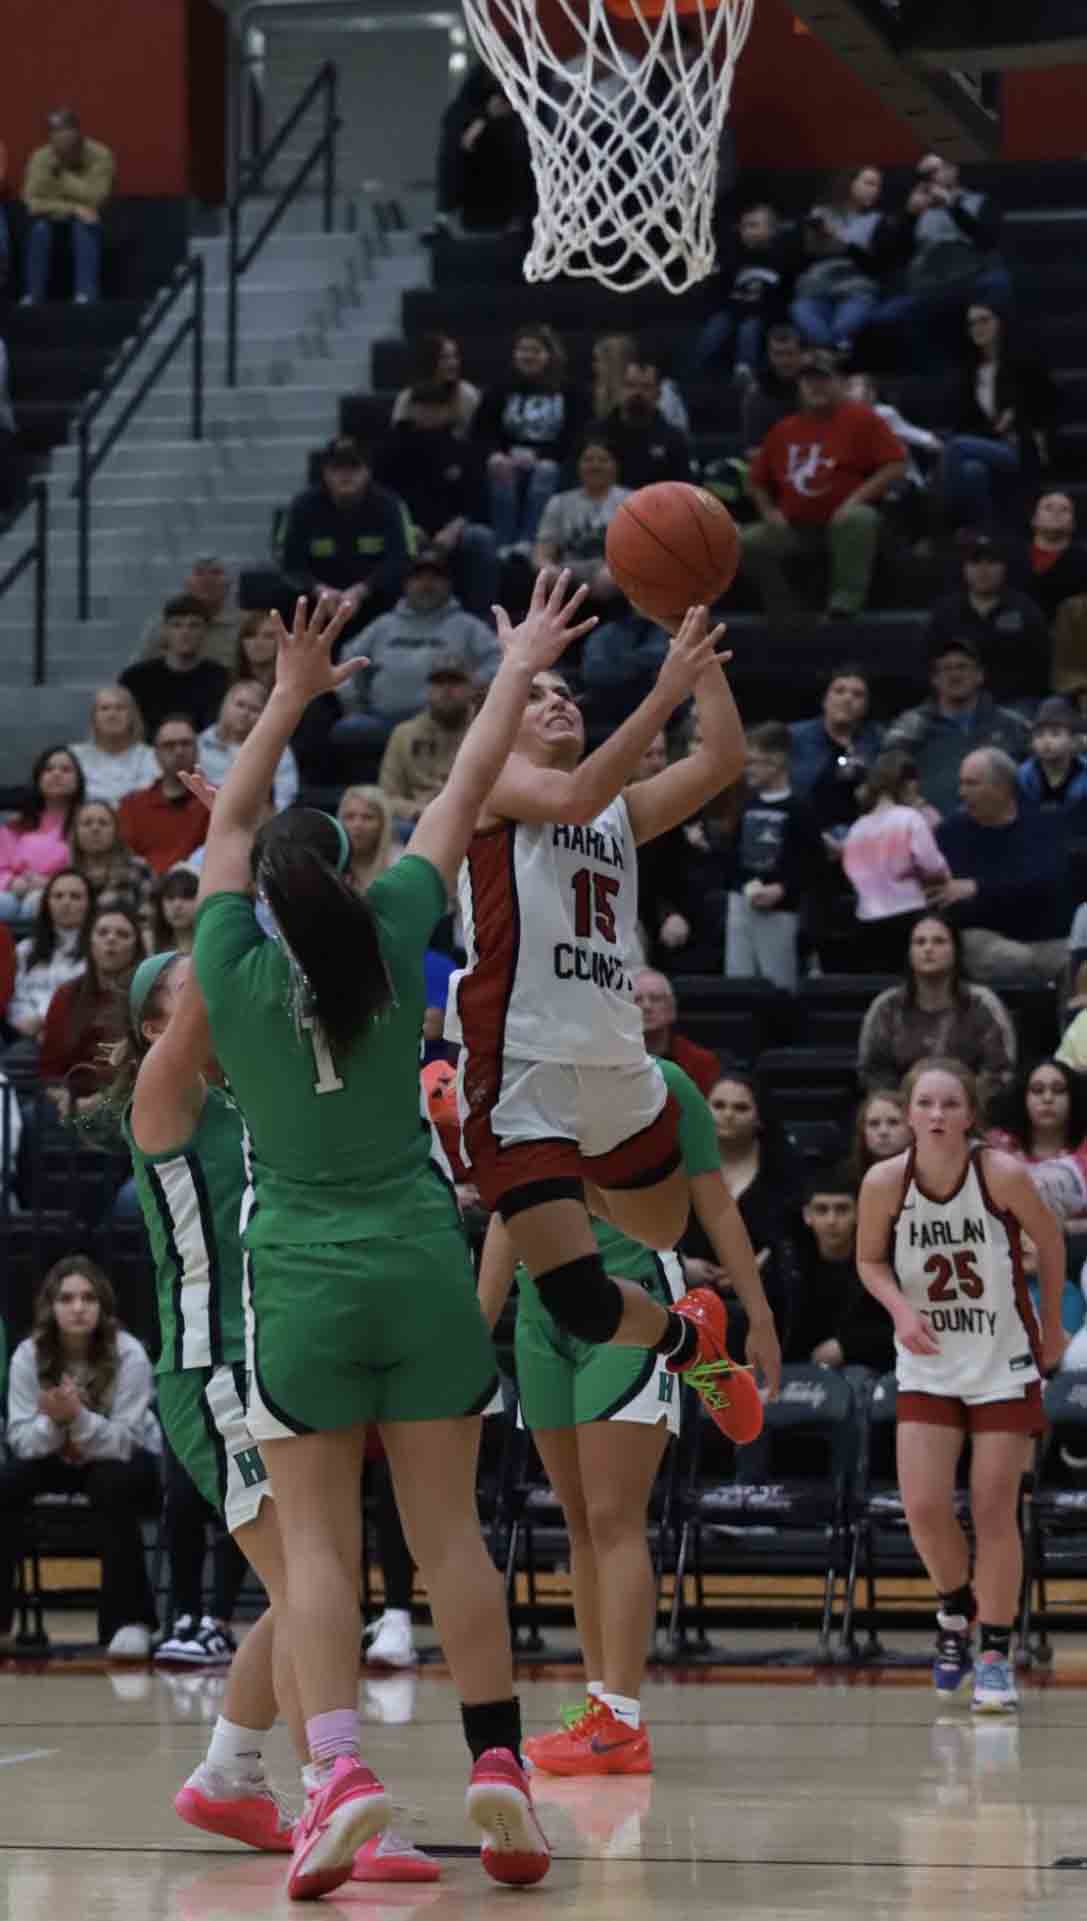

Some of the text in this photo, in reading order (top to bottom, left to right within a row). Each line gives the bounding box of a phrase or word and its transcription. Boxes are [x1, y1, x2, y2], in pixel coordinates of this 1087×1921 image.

[552, 823, 625, 870] HARLA
[571, 867, 621, 945] 15
[554, 942, 633, 991] CONT
[910, 1216, 986, 1248] HARLAN
[924, 1250, 984, 1302] 25
[920, 1307, 996, 1336] OUNTY
[233, 1445, 267, 1488] H
